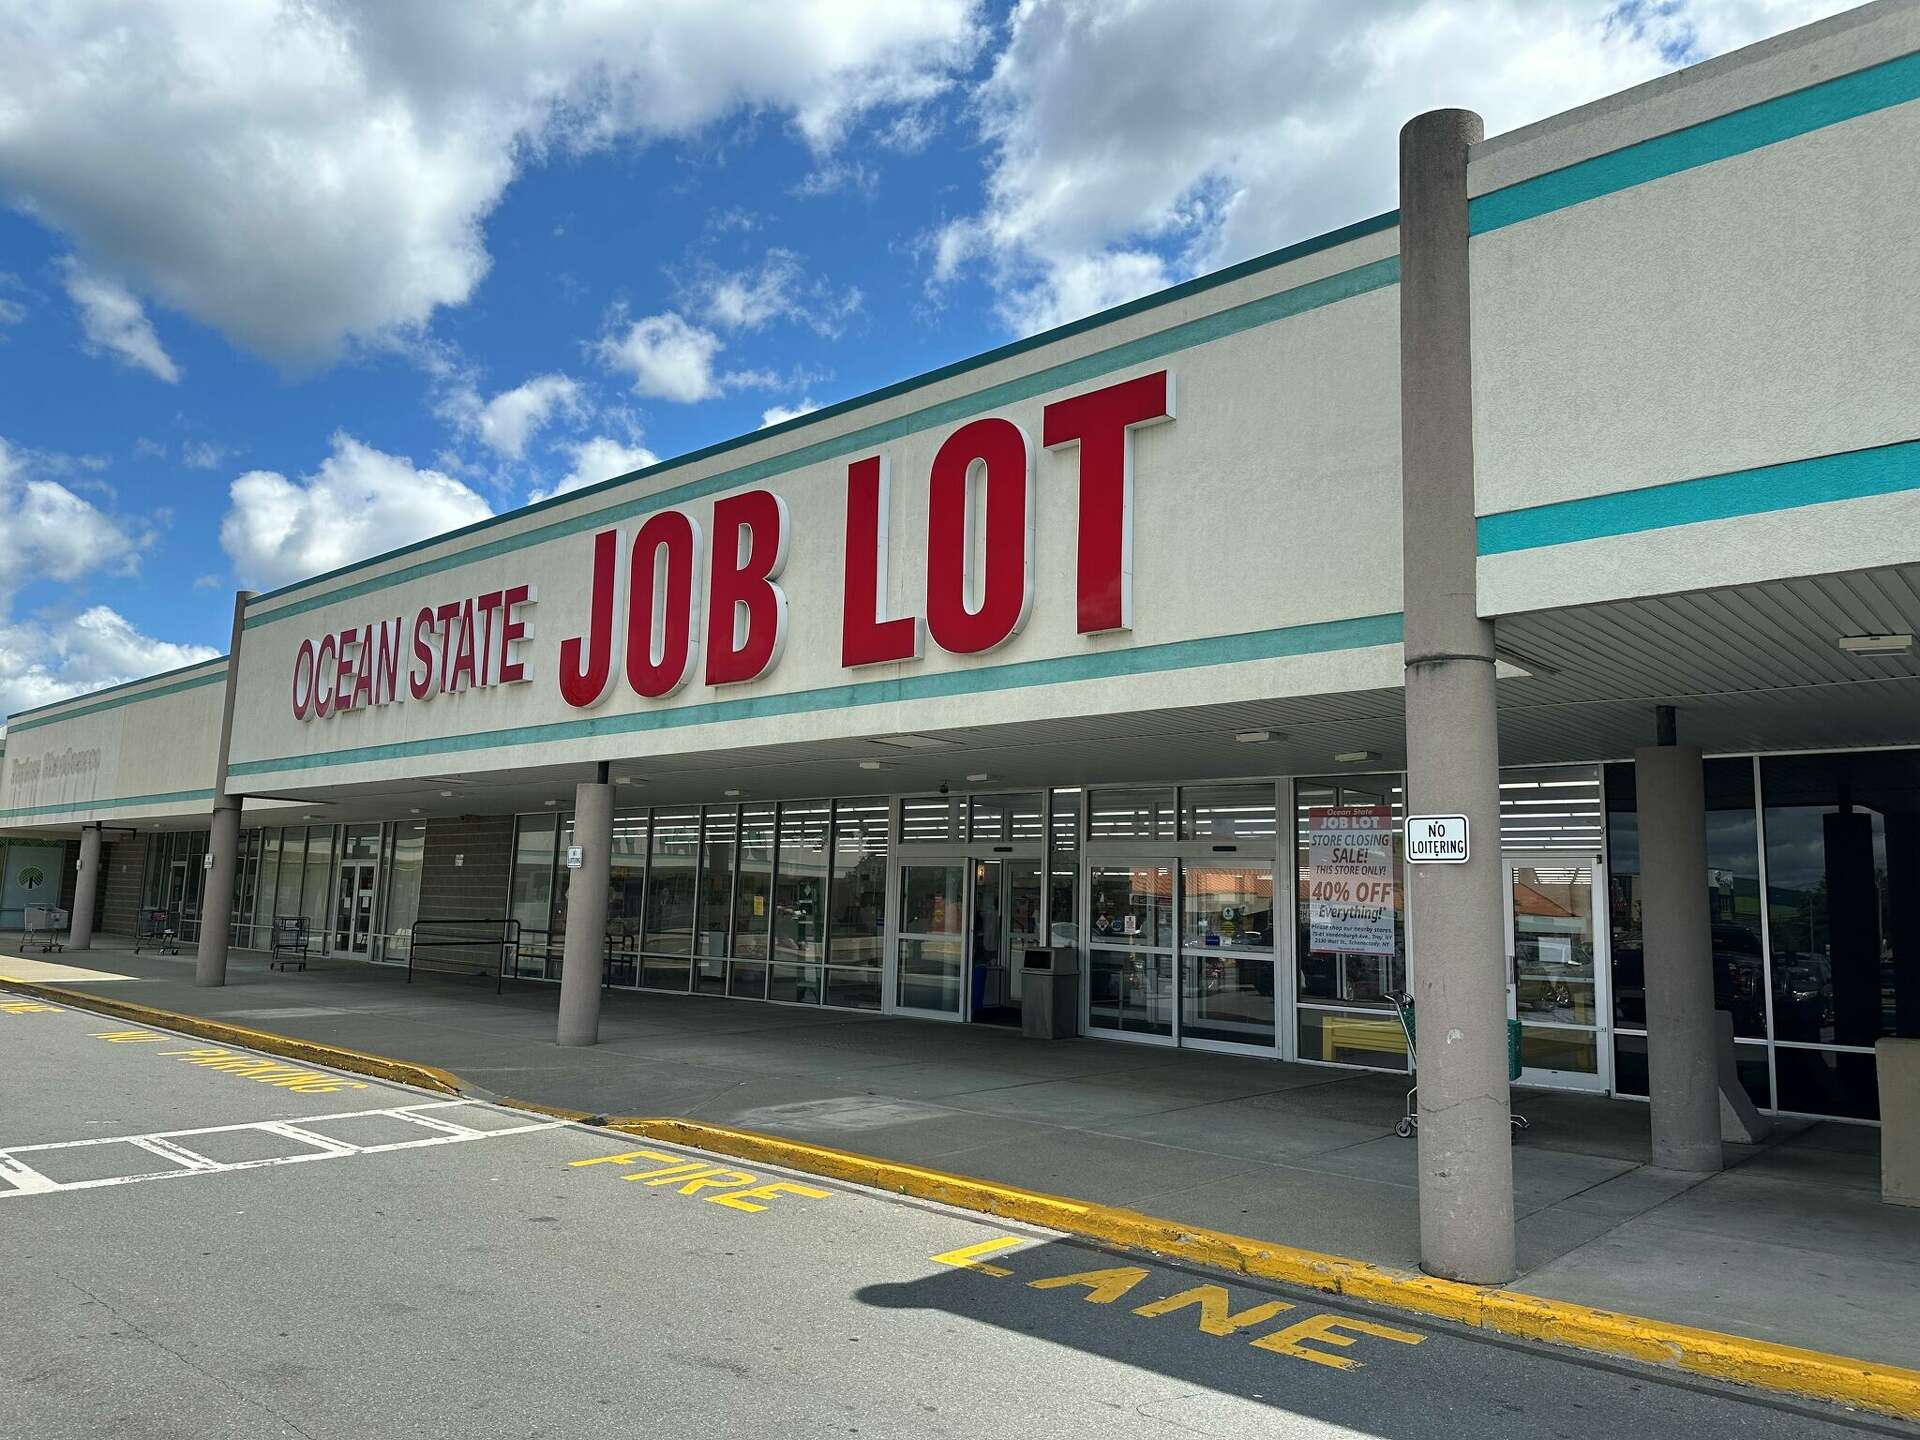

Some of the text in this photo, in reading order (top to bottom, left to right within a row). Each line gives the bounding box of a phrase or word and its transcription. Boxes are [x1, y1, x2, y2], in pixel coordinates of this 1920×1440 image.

[292, 369, 1170, 721] OCEAN STATE JOB LOT
[1353, 808, 1373, 816] State
[1320, 816, 1380, 829] JOB LOT
[1428, 824, 1446, 838] NO
[1312, 834, 1390, 847] STORE CLOSING
[1412, 840, 1464, 854] LOITERING
[1331, 847, 1369, 864] SALE!
[1316, 865, 1387, 876] THIS STORE ONLY!
[1312, 881, 1393, 903] 40% OFF
[87, 1030, 369, 1093] NO PARKING
[568, 1150, 1428, 1371] FIRE LANE
